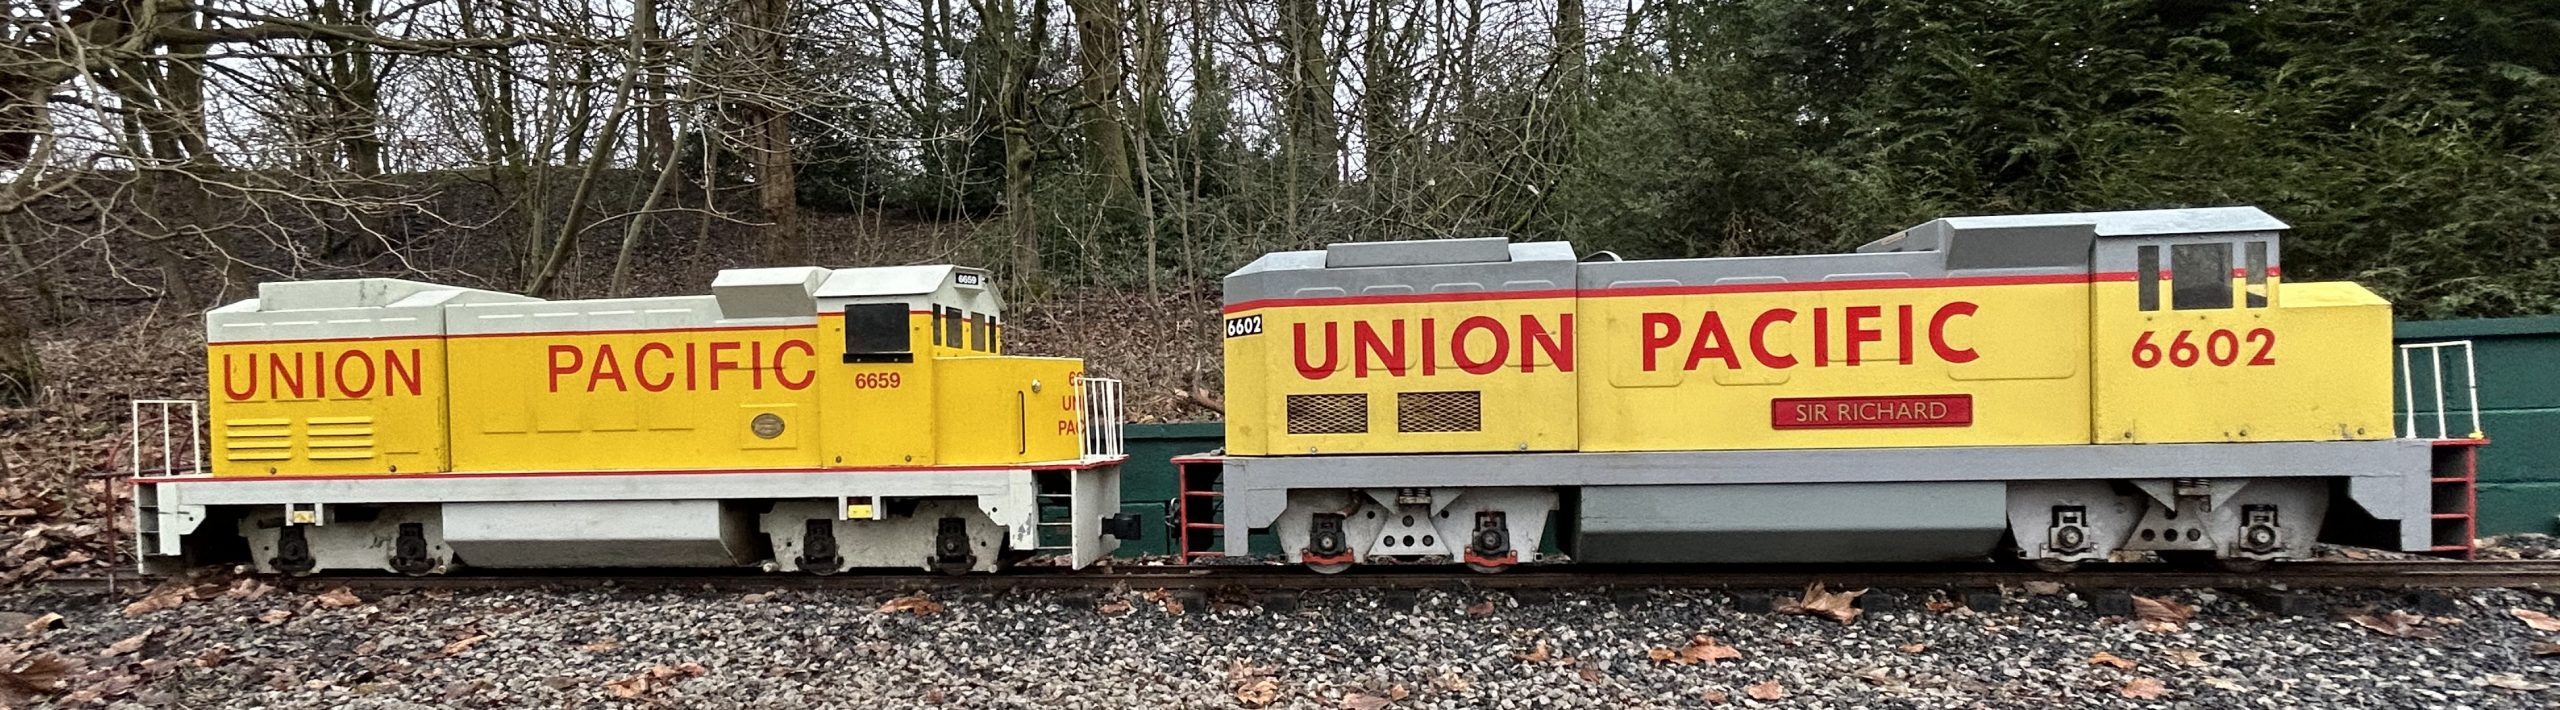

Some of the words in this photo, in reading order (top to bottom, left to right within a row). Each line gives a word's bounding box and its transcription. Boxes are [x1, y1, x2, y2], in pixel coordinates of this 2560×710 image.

[958, 274, 977, 285] 6659
[1227, 316, 1262, 336] 6602
[1293, 313, 1574, 380] UNION
[1642, 301, 1980, 371] PACIFIC
[2131, 327, 2276, 369] 6602
[223, 349, 421, 401] UNION
[548, 339, 816, 392] PACIFIC
[855, 372, 901, 389] 6659
[1796, 404, 1829, 422] SIR
[1837, 401, 1947, 421] RICHARD
